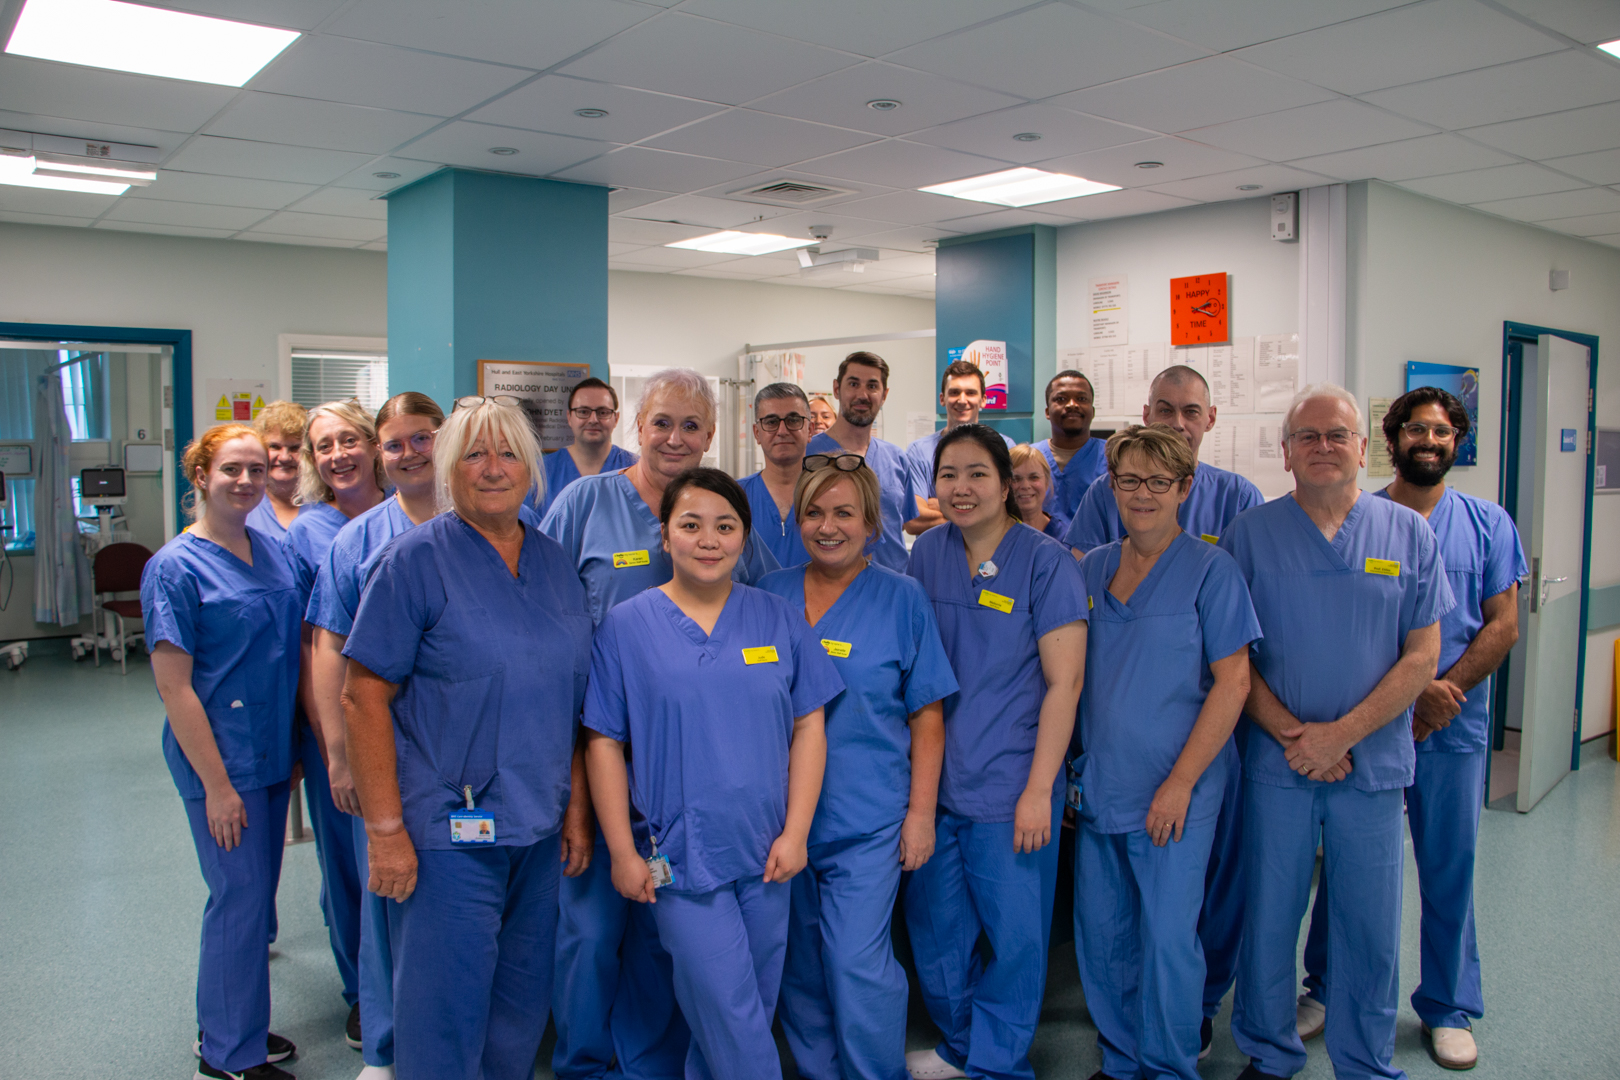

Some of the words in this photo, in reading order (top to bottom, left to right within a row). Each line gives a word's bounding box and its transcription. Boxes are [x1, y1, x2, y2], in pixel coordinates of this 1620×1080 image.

[1186, 289, 1210, 298] HAPPY
[1190, 320, 1206, 328] TIME
[494, 384, 541, 392] RADIOLOGY
[137, 429, 146, 440] 6
